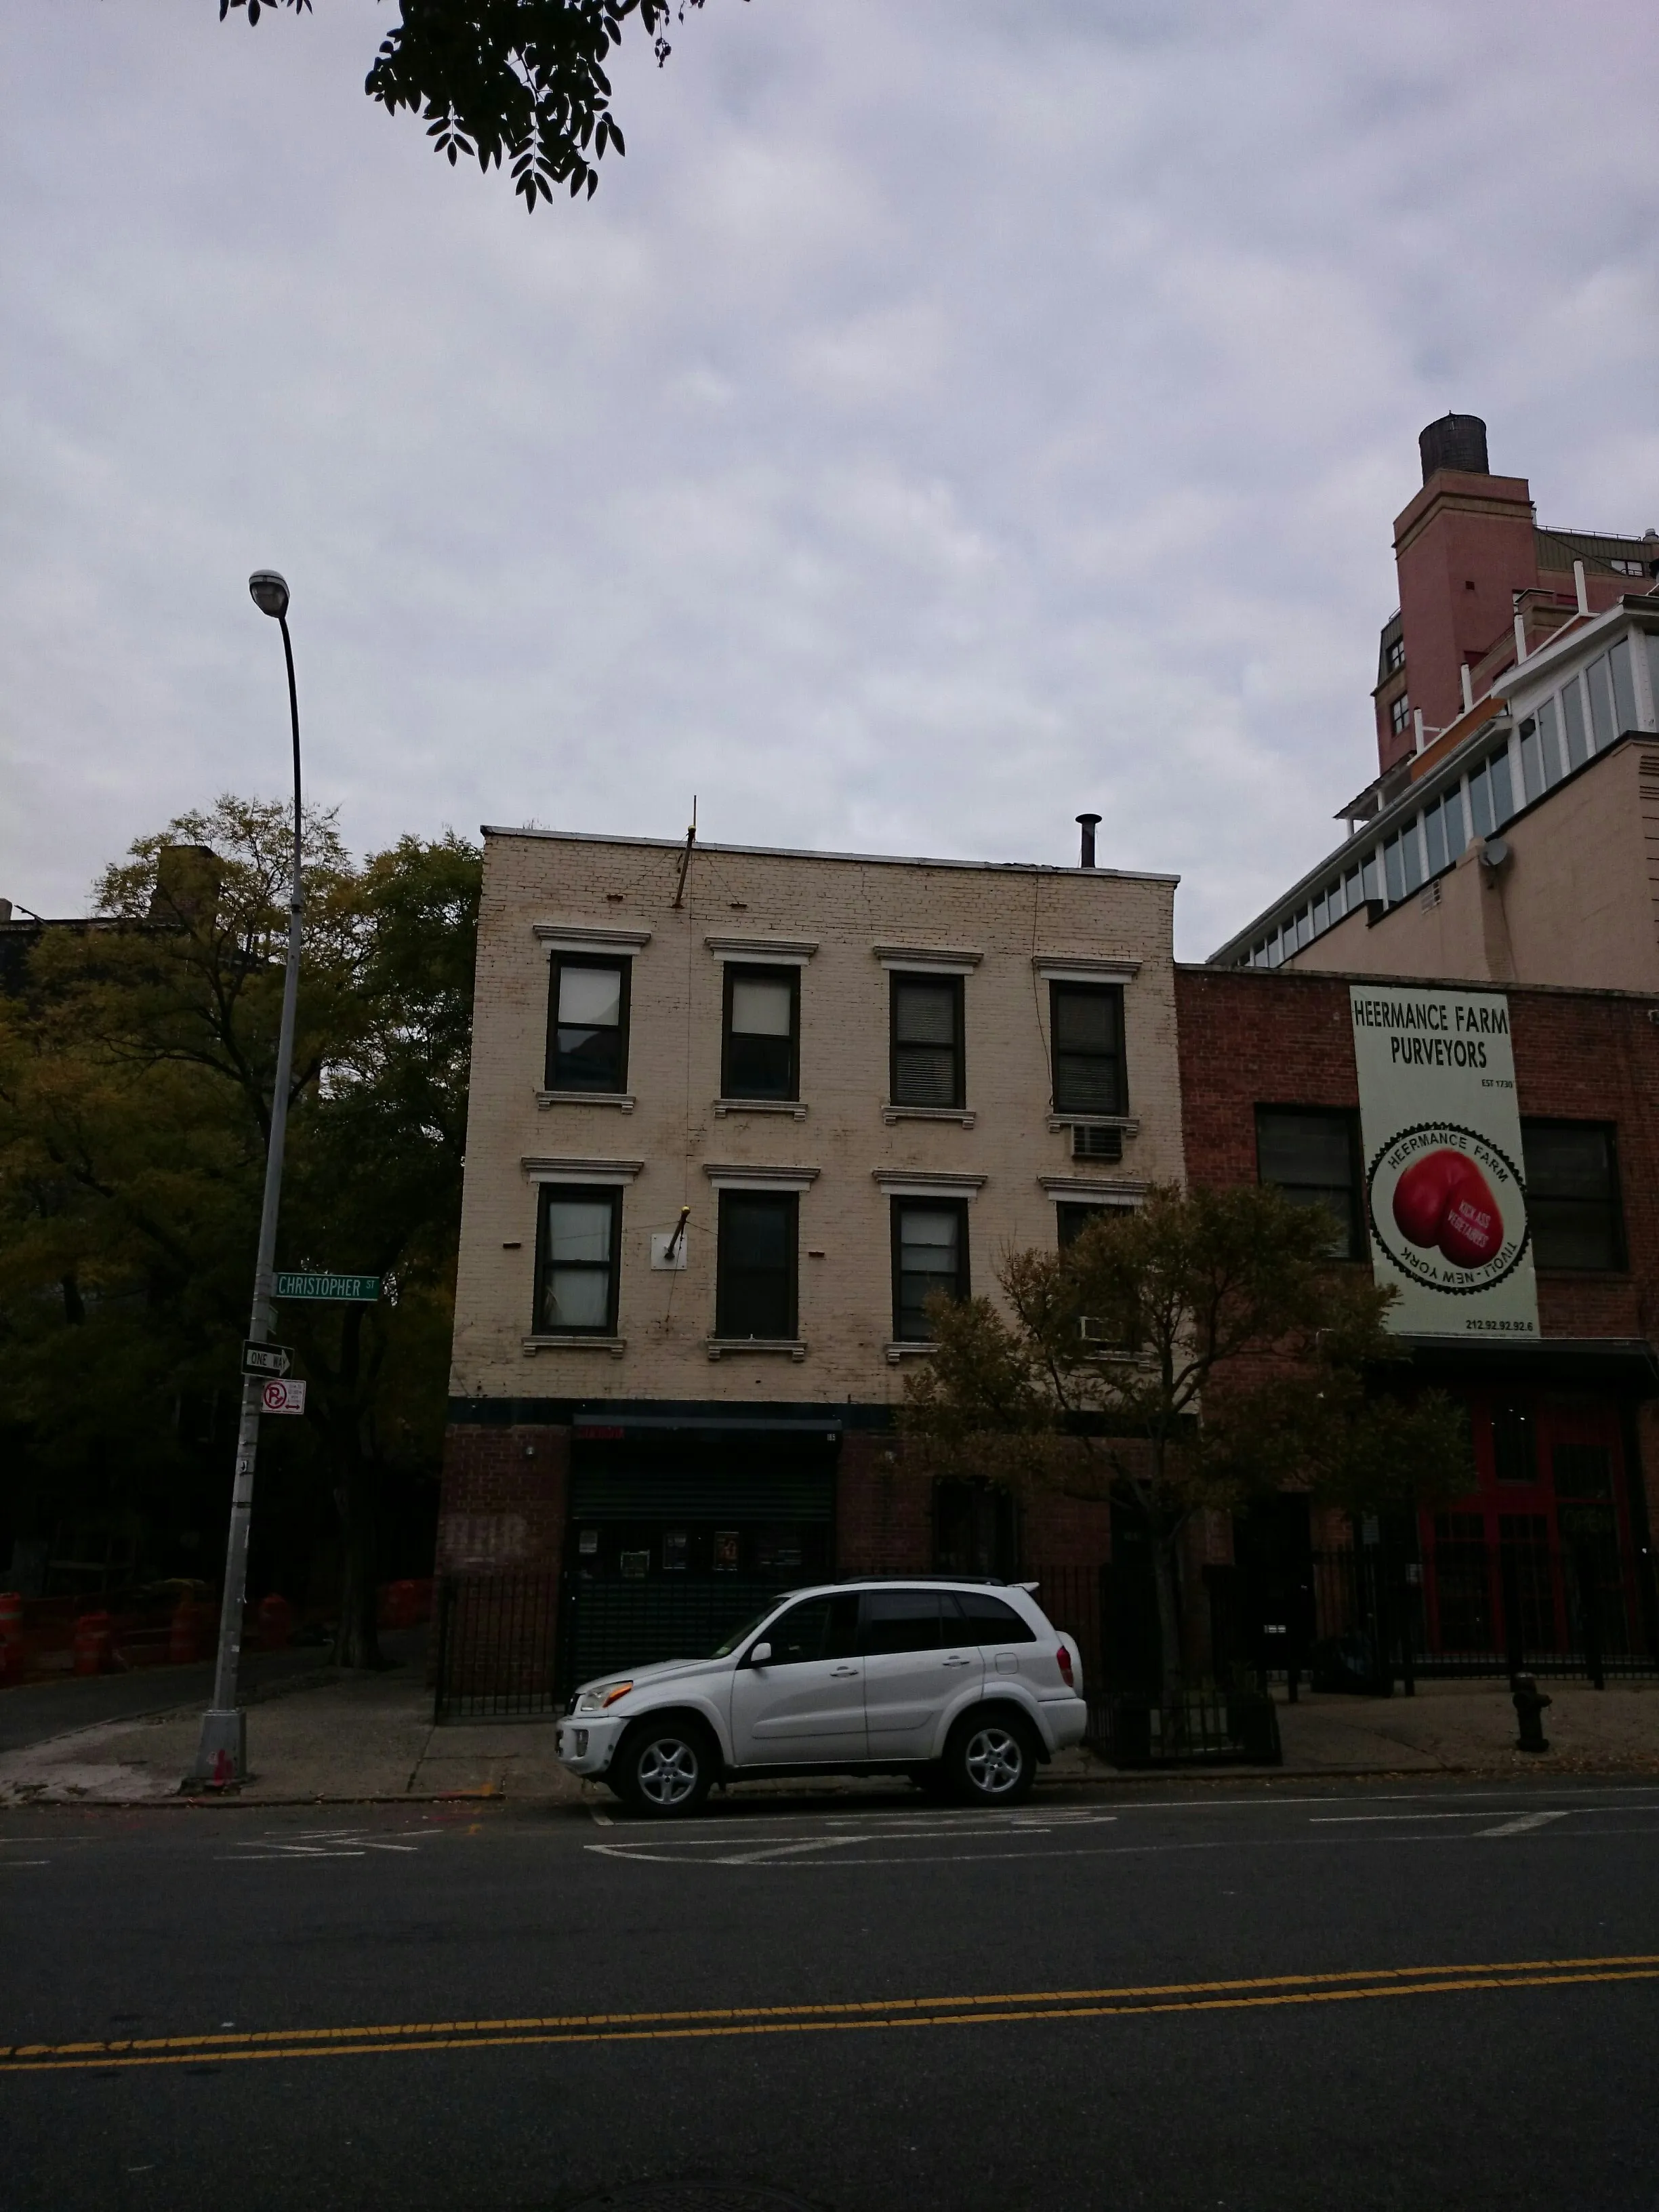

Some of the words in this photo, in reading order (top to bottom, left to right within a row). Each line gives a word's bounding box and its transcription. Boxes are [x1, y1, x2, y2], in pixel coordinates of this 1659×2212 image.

[1354, 1000, 1448, 1031] HEERMANCE
[1456, 1006, 1509, 1034] FARM
[1391, 1037, 1487, 1068] PURVEYORS
[1481, 1079, 1493, 1087] EST
[1388, 1132, 1467, 1169] HEERMANCE
[1474, 1145, 1509, 1183] FARM
[1401, 1247, 1437, 1279] YORK
[1483, 1242, 1517, 1277] TIVOLI
[279, 1276, 361, 1296] CHRISTOPHER
[366, 1280, 375, 1289] ST
[1443, 1271, 1474, 1284] NEW
[251, 1352, 267, 1366] ONE
[273, 1355, 285, 1370] WAY
